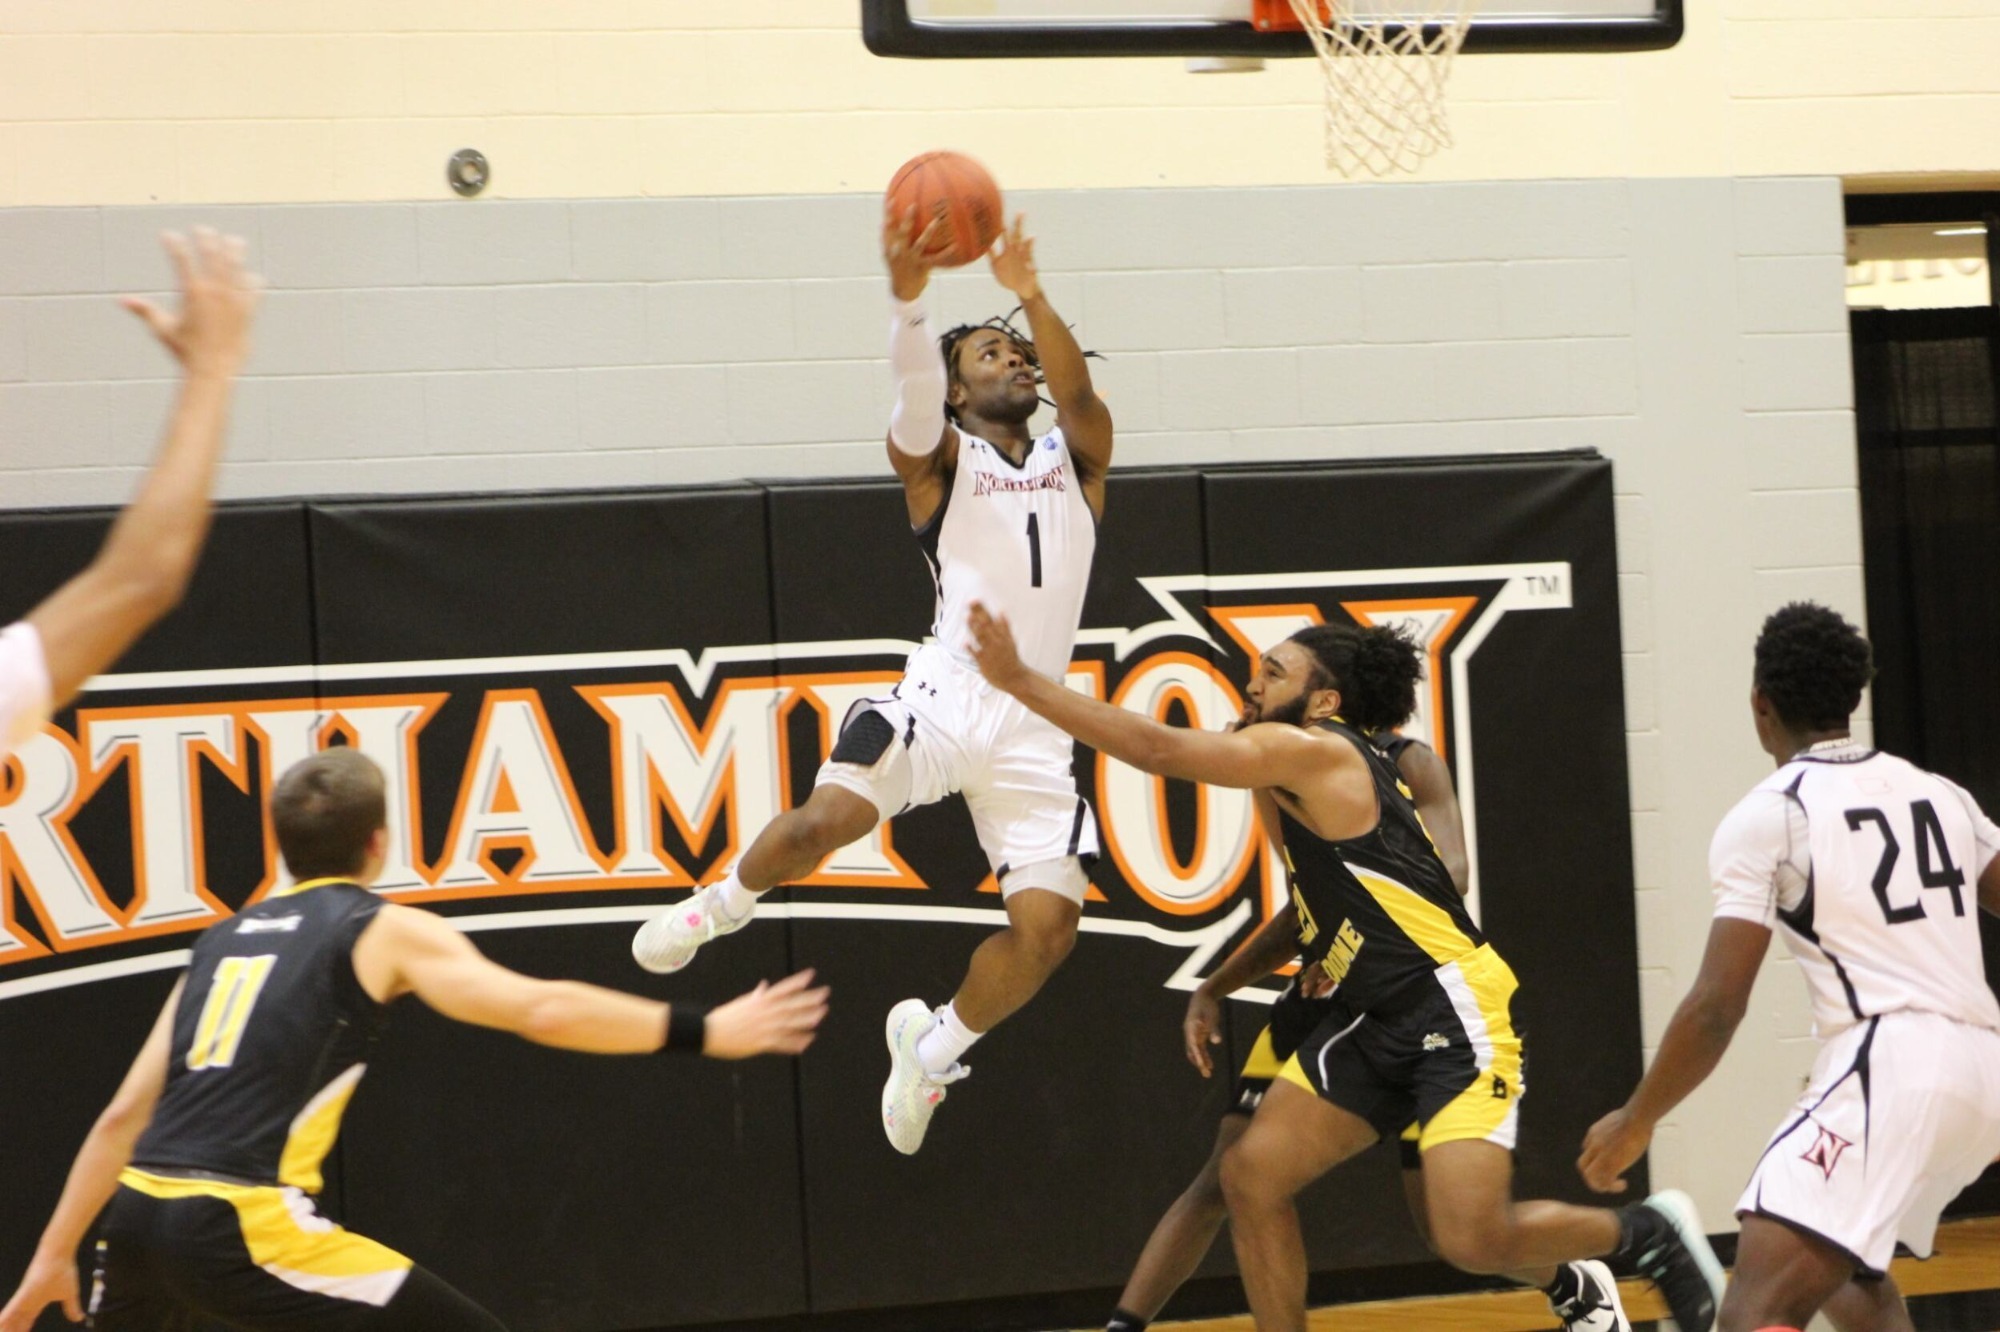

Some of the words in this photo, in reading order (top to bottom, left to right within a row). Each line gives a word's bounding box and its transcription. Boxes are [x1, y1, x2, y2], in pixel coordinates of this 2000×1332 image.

[1026, 512, 1042, 588] 1
[1524, 575, 1561, 596] TM
[1844, 799, 1966, 925] 24
[186, 954, 278, 1070] 11
[1800, 1126, 1853, 1181] N
